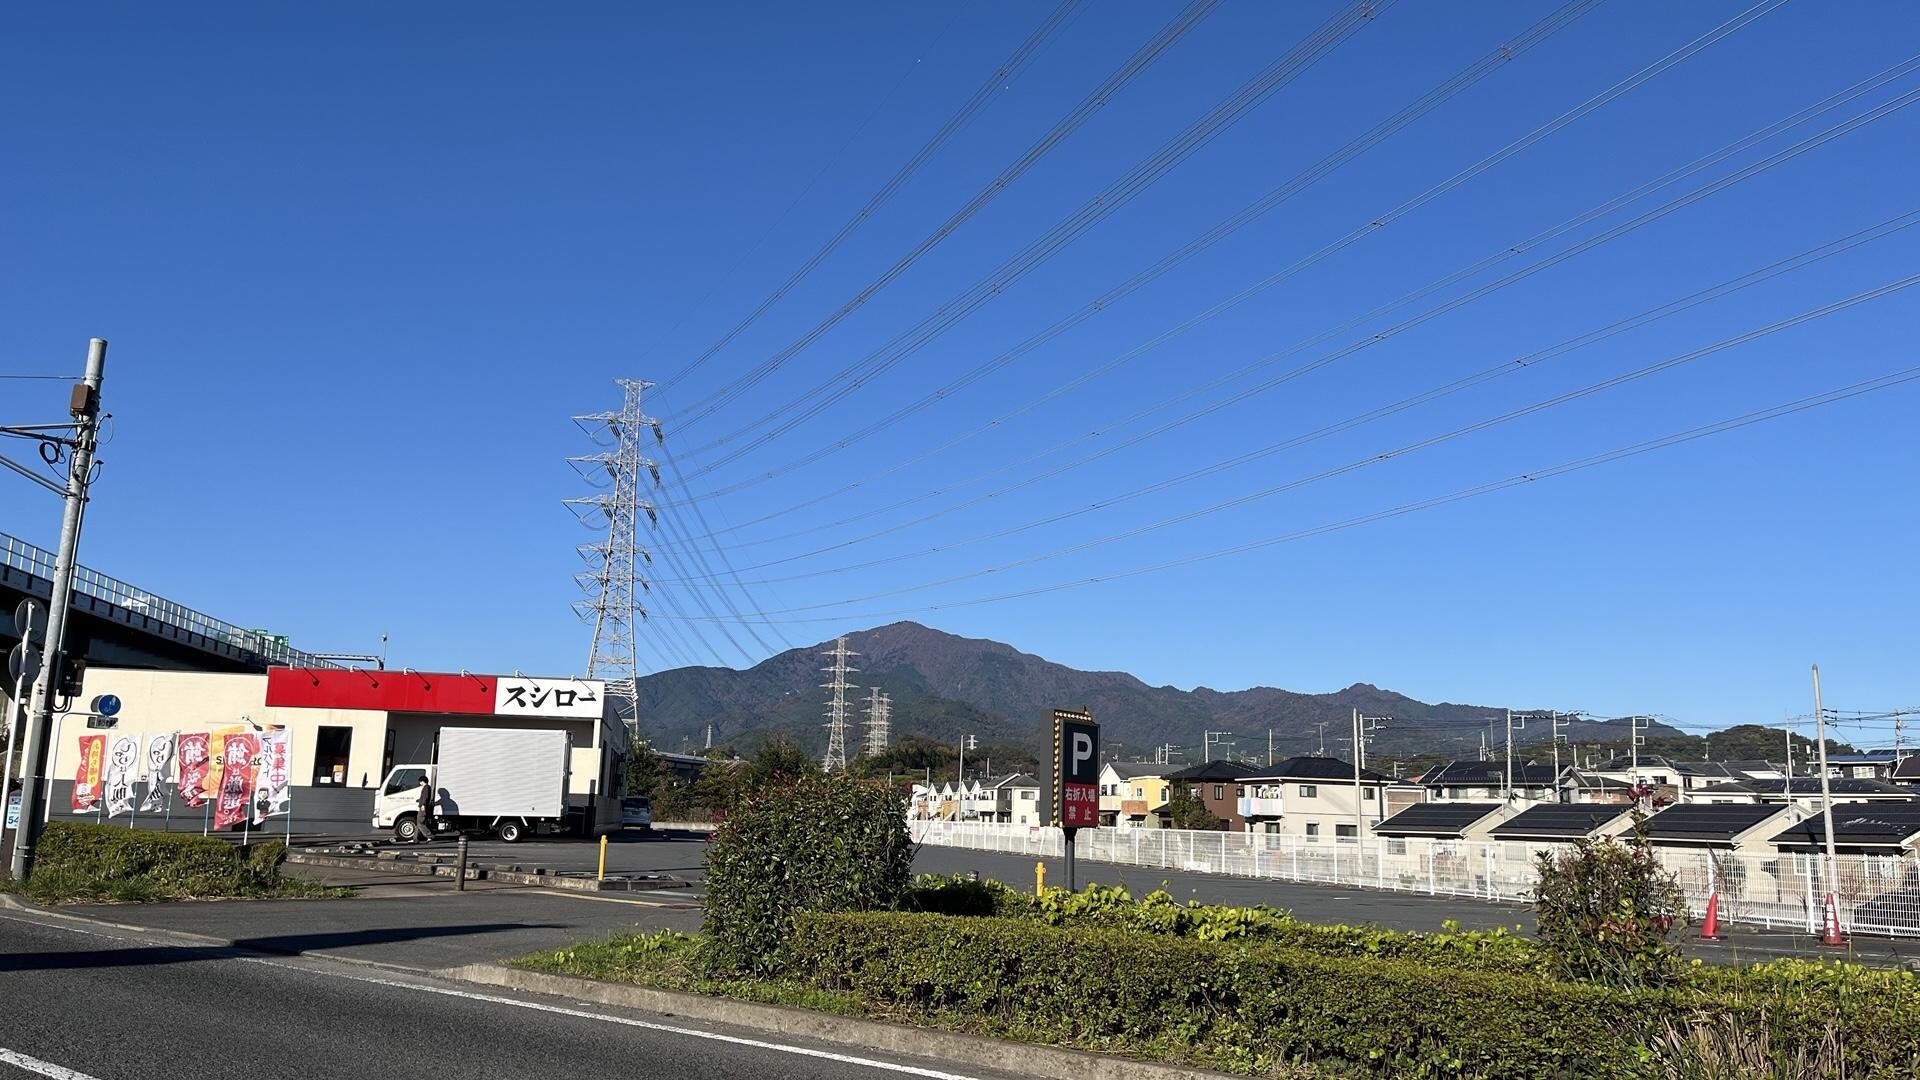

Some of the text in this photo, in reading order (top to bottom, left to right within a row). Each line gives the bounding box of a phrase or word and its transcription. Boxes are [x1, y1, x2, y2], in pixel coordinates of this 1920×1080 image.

[503, 686, 597, 708] スシロー
[1072, 732, 1093, 776] P
[1065, 787, 1096, 803] 右折入場
